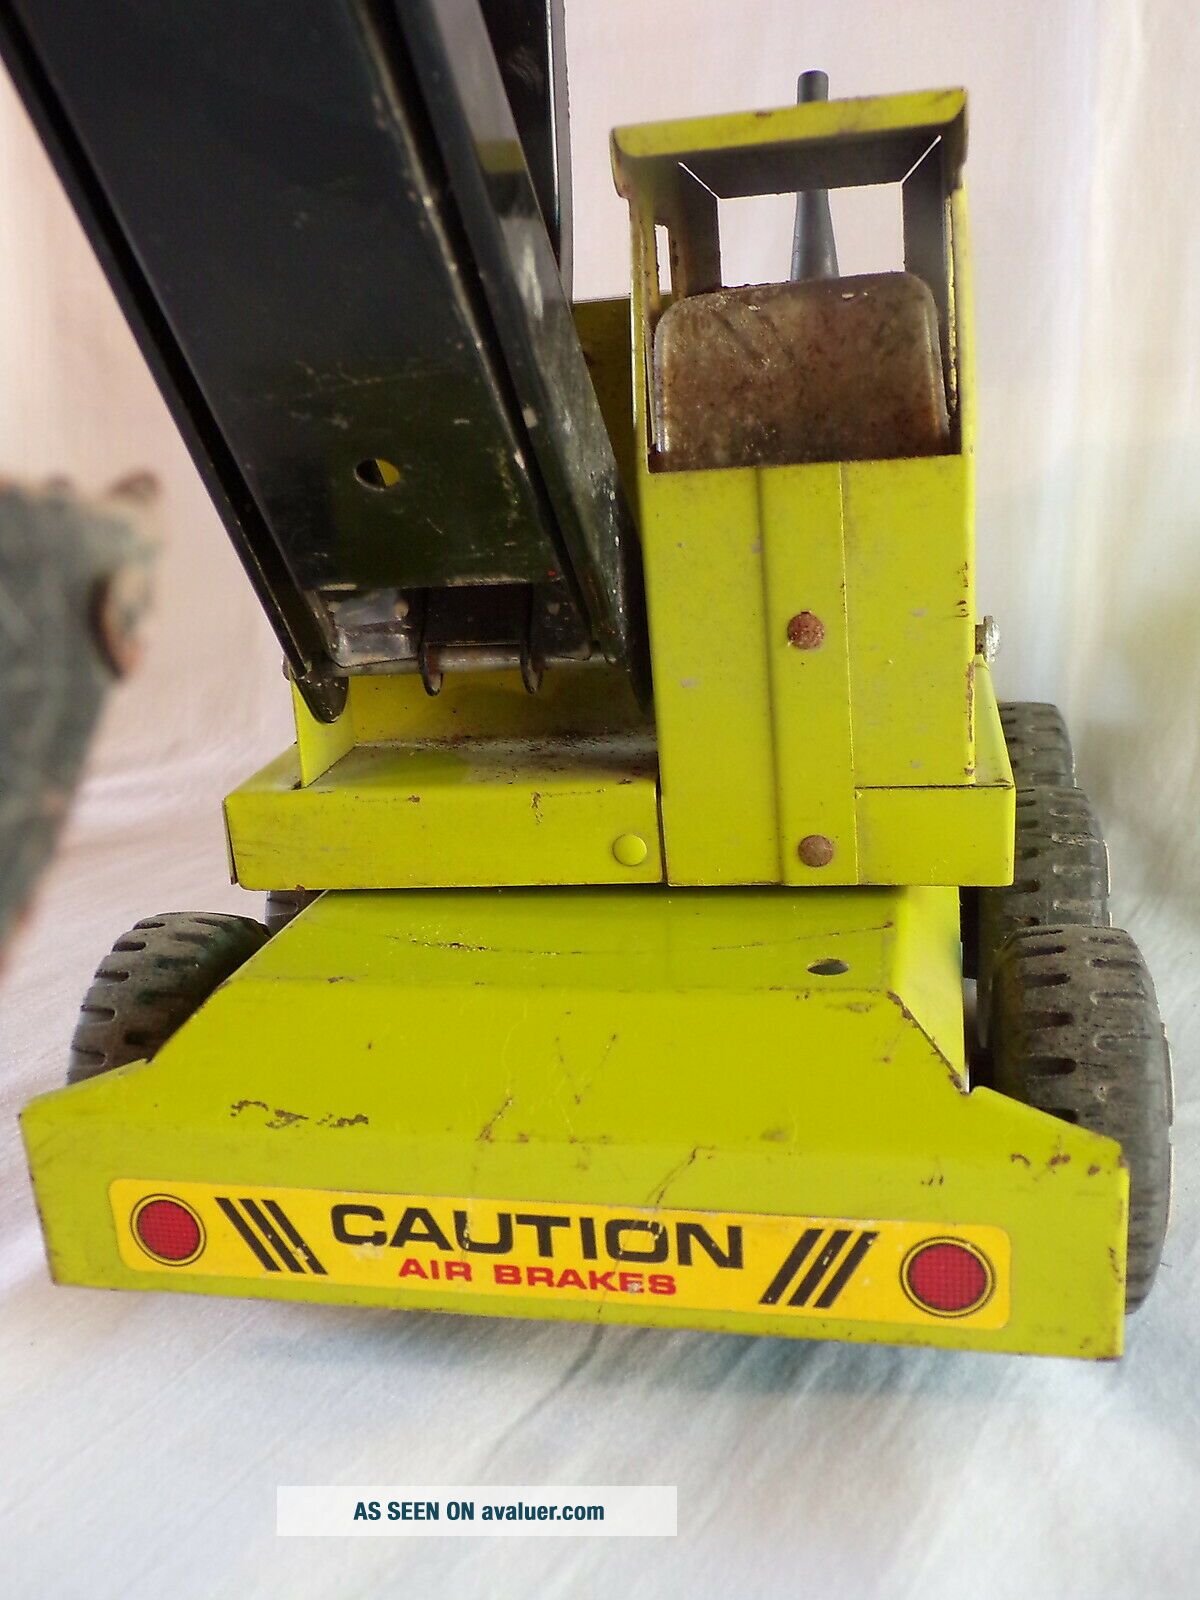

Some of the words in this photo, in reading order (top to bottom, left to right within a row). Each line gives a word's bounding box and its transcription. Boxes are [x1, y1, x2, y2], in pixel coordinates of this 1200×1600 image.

[331, 1203, 744, 1270] CAUTION
[399, 1258, 473, 1282] AIR
[493, 1264, 678, 1296] BRAKES
